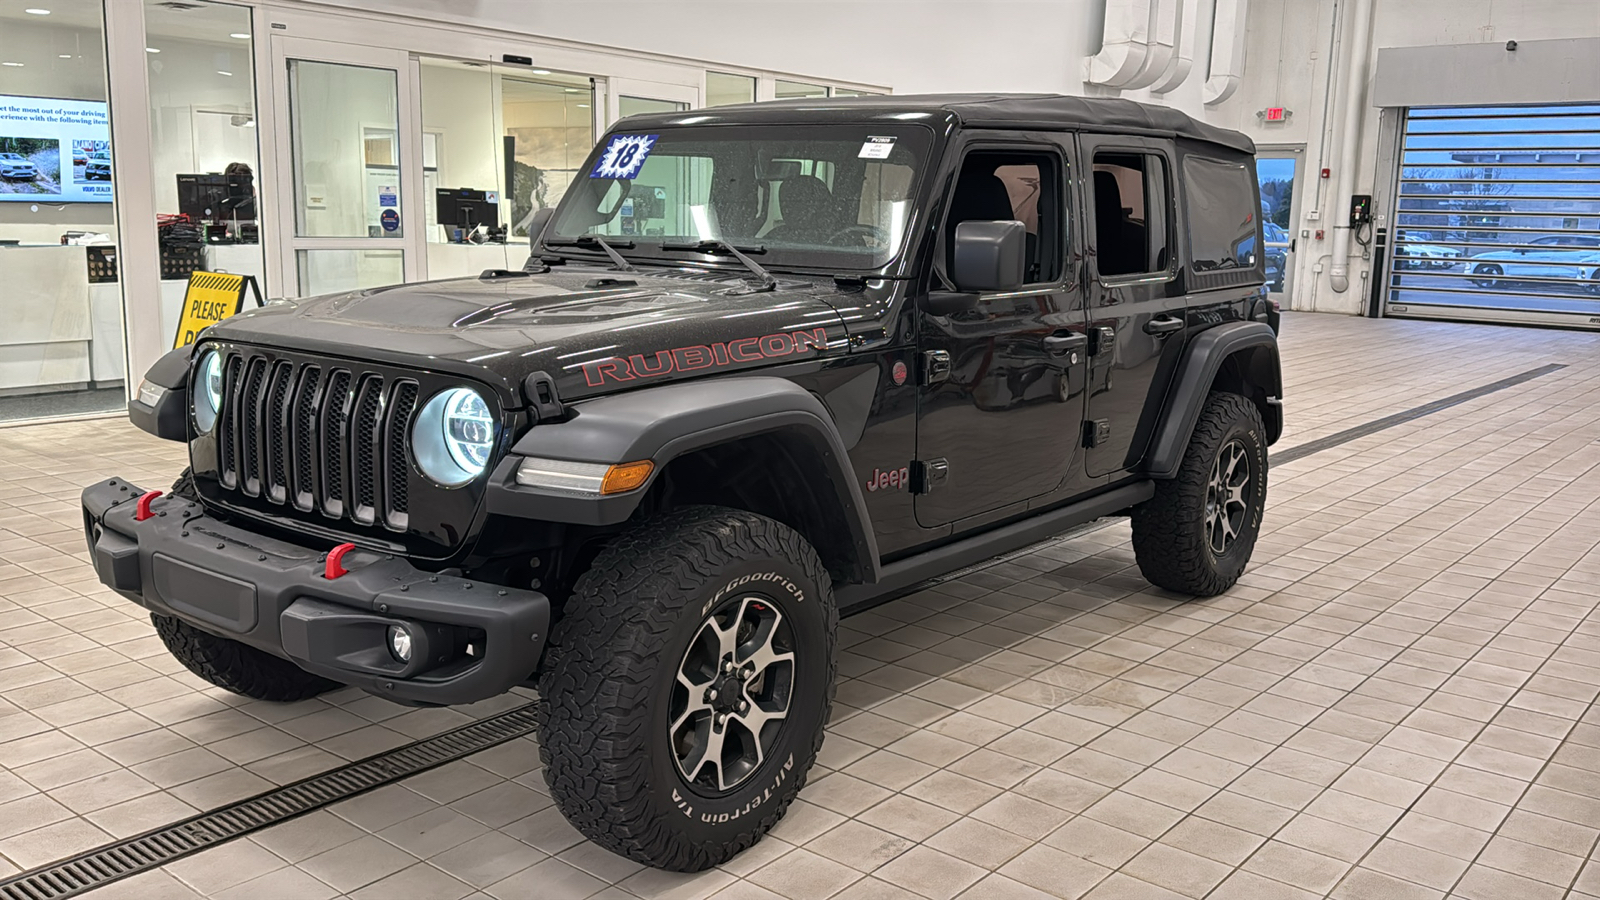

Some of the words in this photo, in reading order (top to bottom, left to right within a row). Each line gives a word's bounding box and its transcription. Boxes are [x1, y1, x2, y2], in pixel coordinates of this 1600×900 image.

[60, 117, 92, 125] following
[81, 110, 105, 118] driving
[1267, 107, 1283, 120] EXIT
[611, 143, 640, 168] 18
[190, 300, 227, 321] PLEASE
[582, 328, 827, 387] RUBICON
[866, 467, 909, 492] Jeep
[701, 571, 805, 617] BFGoodrich
[701, 752, 794, 826] All-Terrain
[671, 788, 694, 818] T/A
